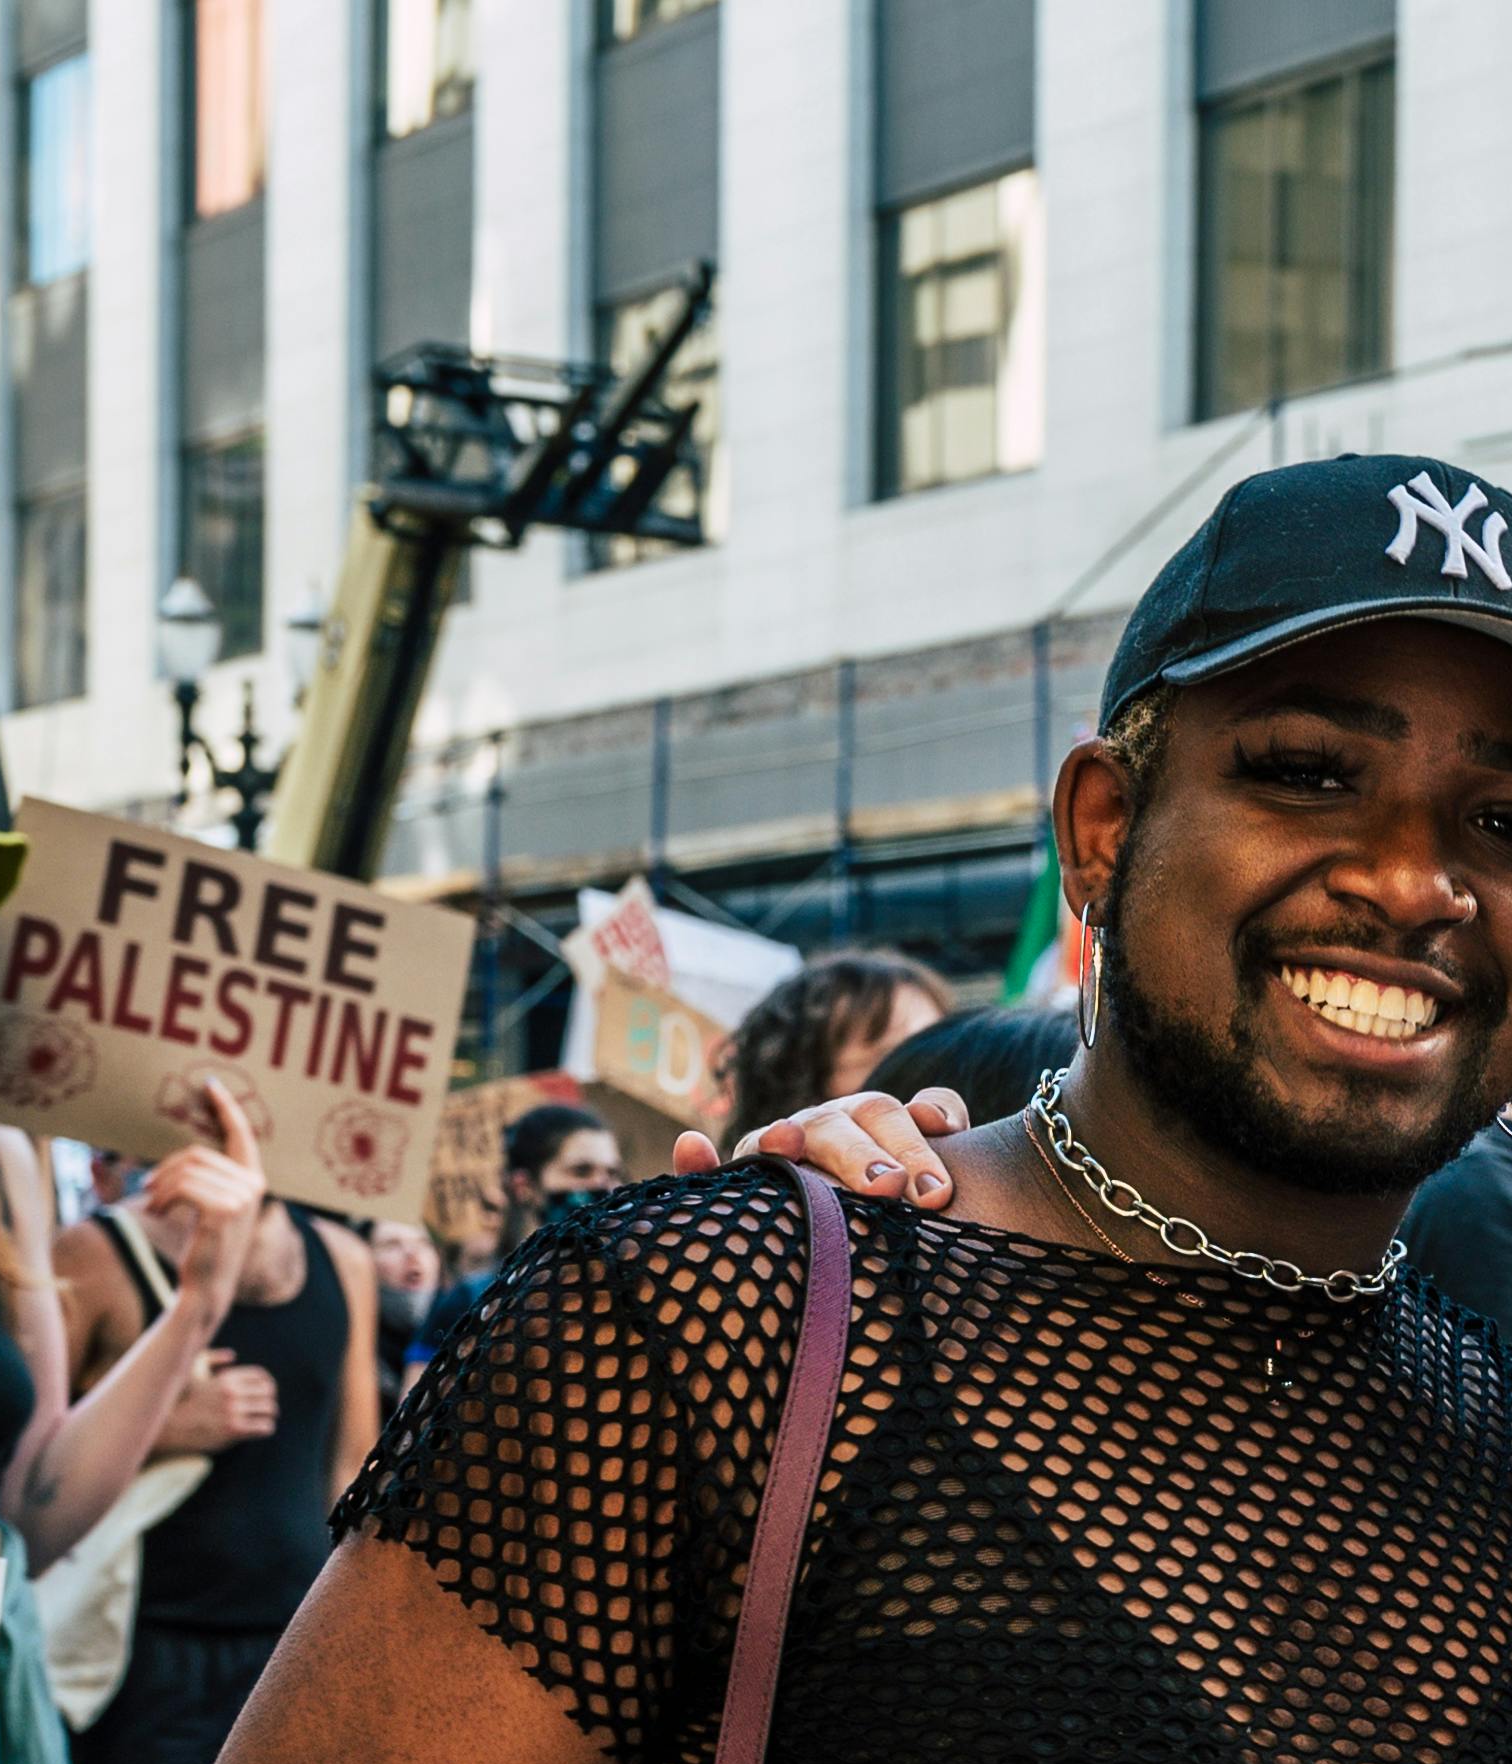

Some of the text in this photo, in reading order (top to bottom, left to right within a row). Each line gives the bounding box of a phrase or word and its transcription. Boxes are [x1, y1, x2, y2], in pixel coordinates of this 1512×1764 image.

[1385, 470, 1512, 590] NY
[96, 839, 385, 993] FREE
[1, 915, 435, 1106] PALESTINE
